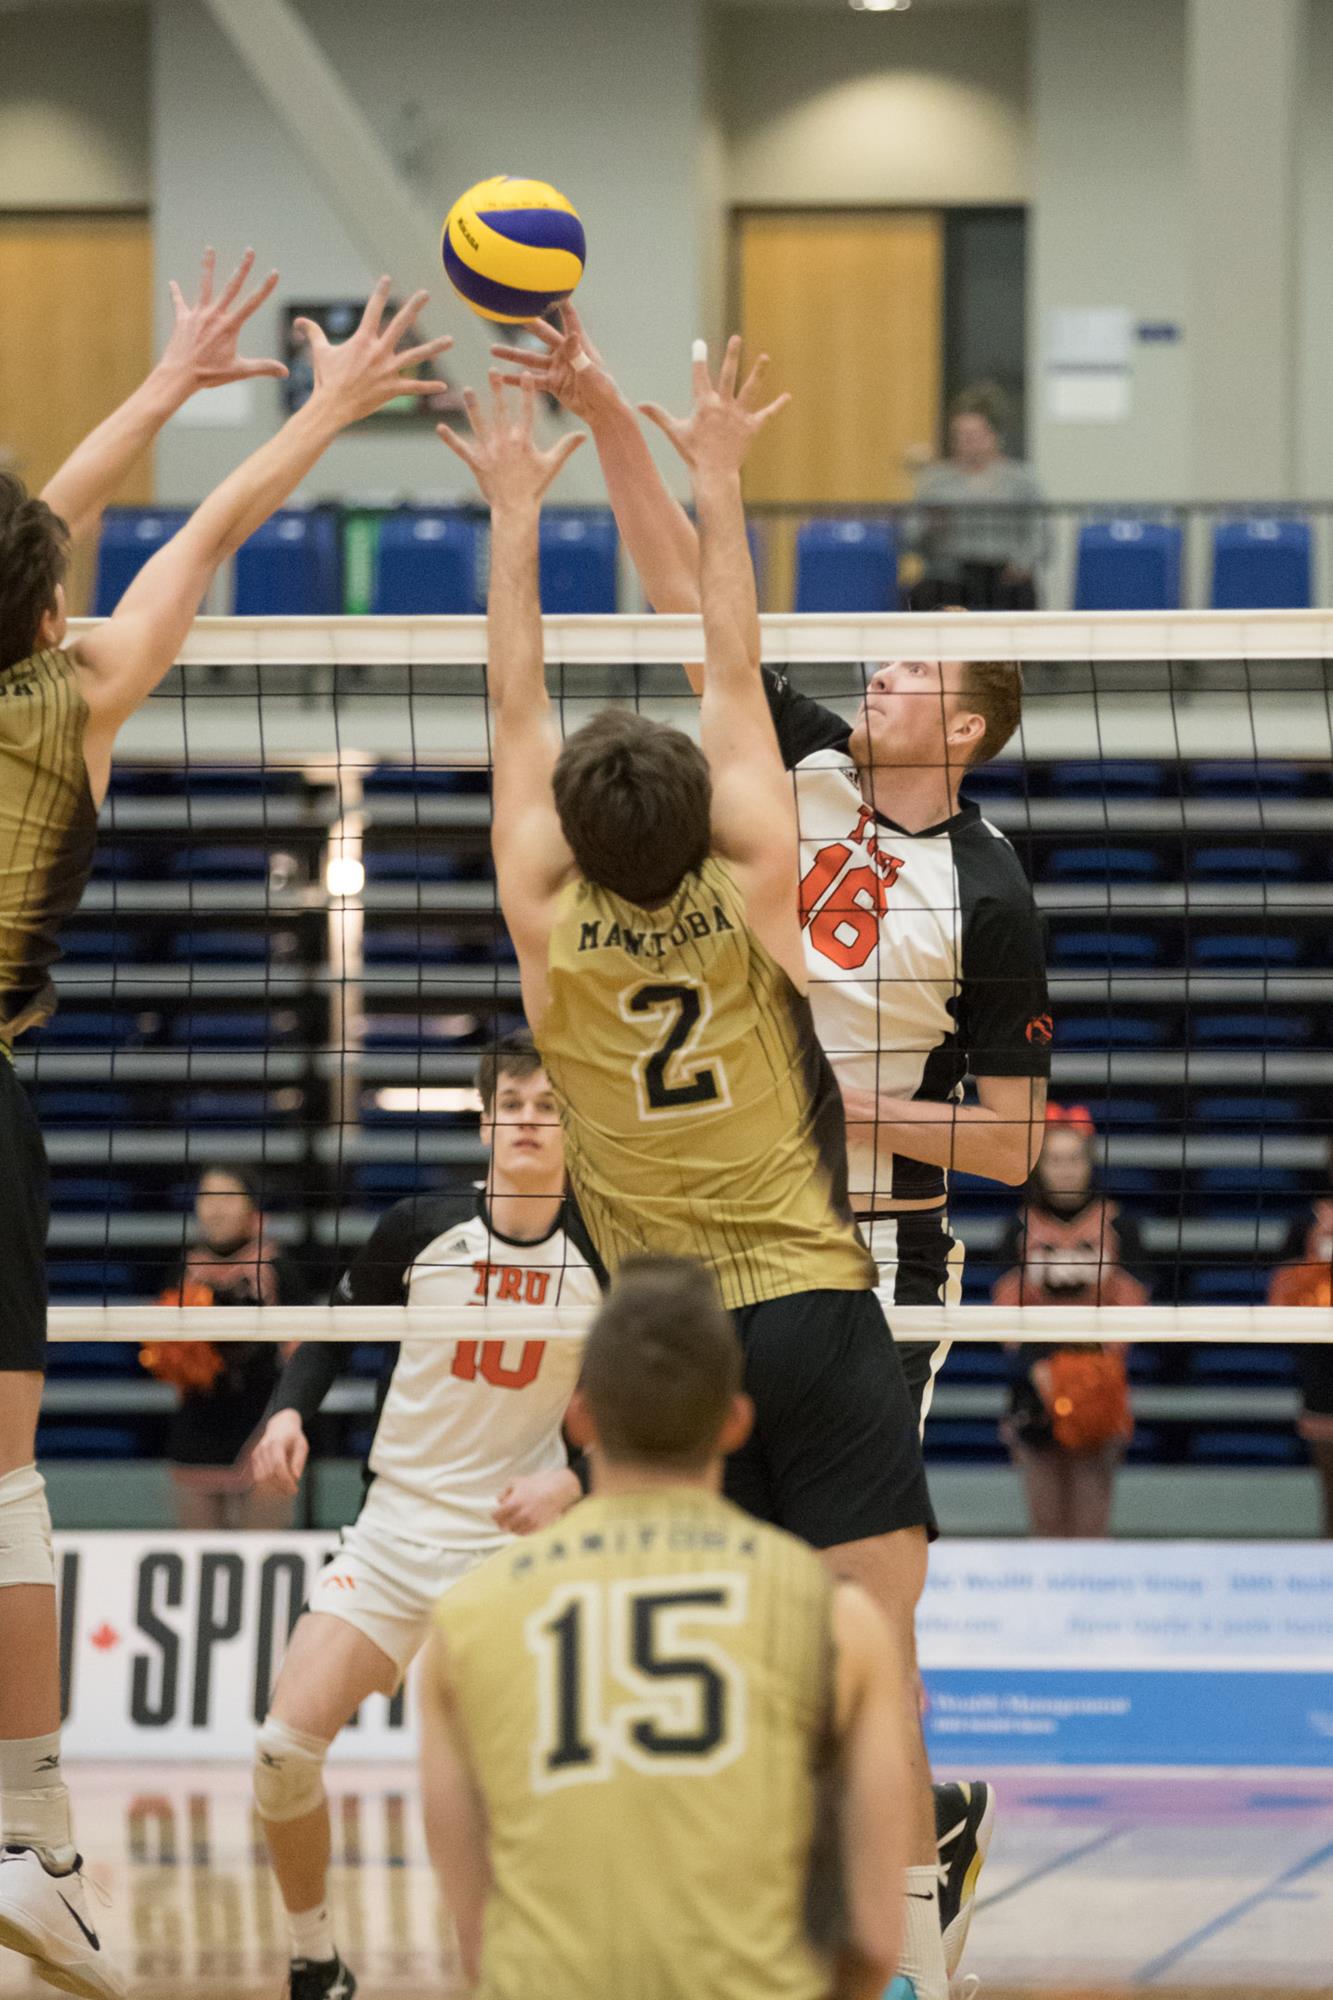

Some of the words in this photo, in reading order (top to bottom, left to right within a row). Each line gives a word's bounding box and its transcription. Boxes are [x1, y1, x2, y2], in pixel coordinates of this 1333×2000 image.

[798, 842, 888, 970] 16
[617, 975, 734, 1122] 2
[472, 1261, 550, 1305] TRU
[524, 1571, 748, 1795] 15
